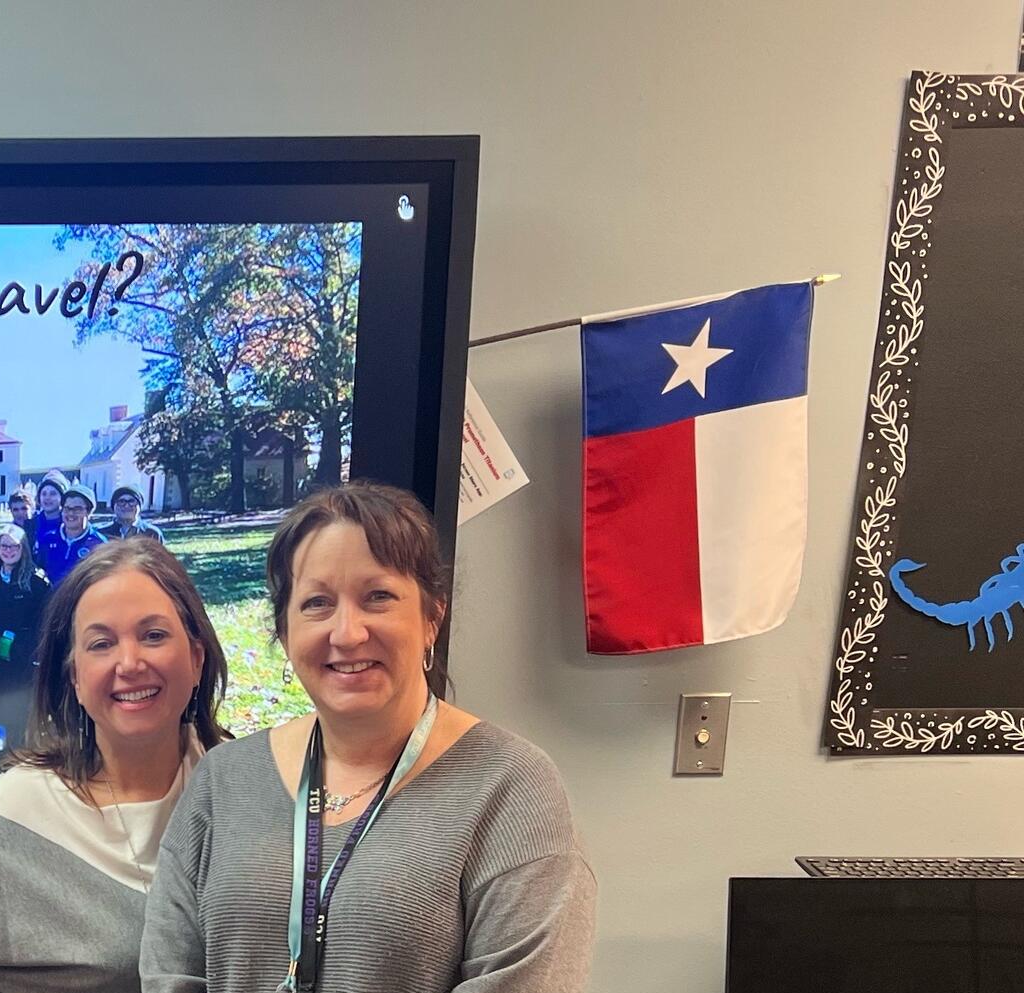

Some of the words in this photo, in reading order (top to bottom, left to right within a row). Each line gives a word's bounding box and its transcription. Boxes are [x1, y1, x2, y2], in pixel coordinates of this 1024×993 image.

[308, 788, 321, 814] TCU
[306, 819, 320, 873] HORNED
[304, 879, 319, 925] FROGS
